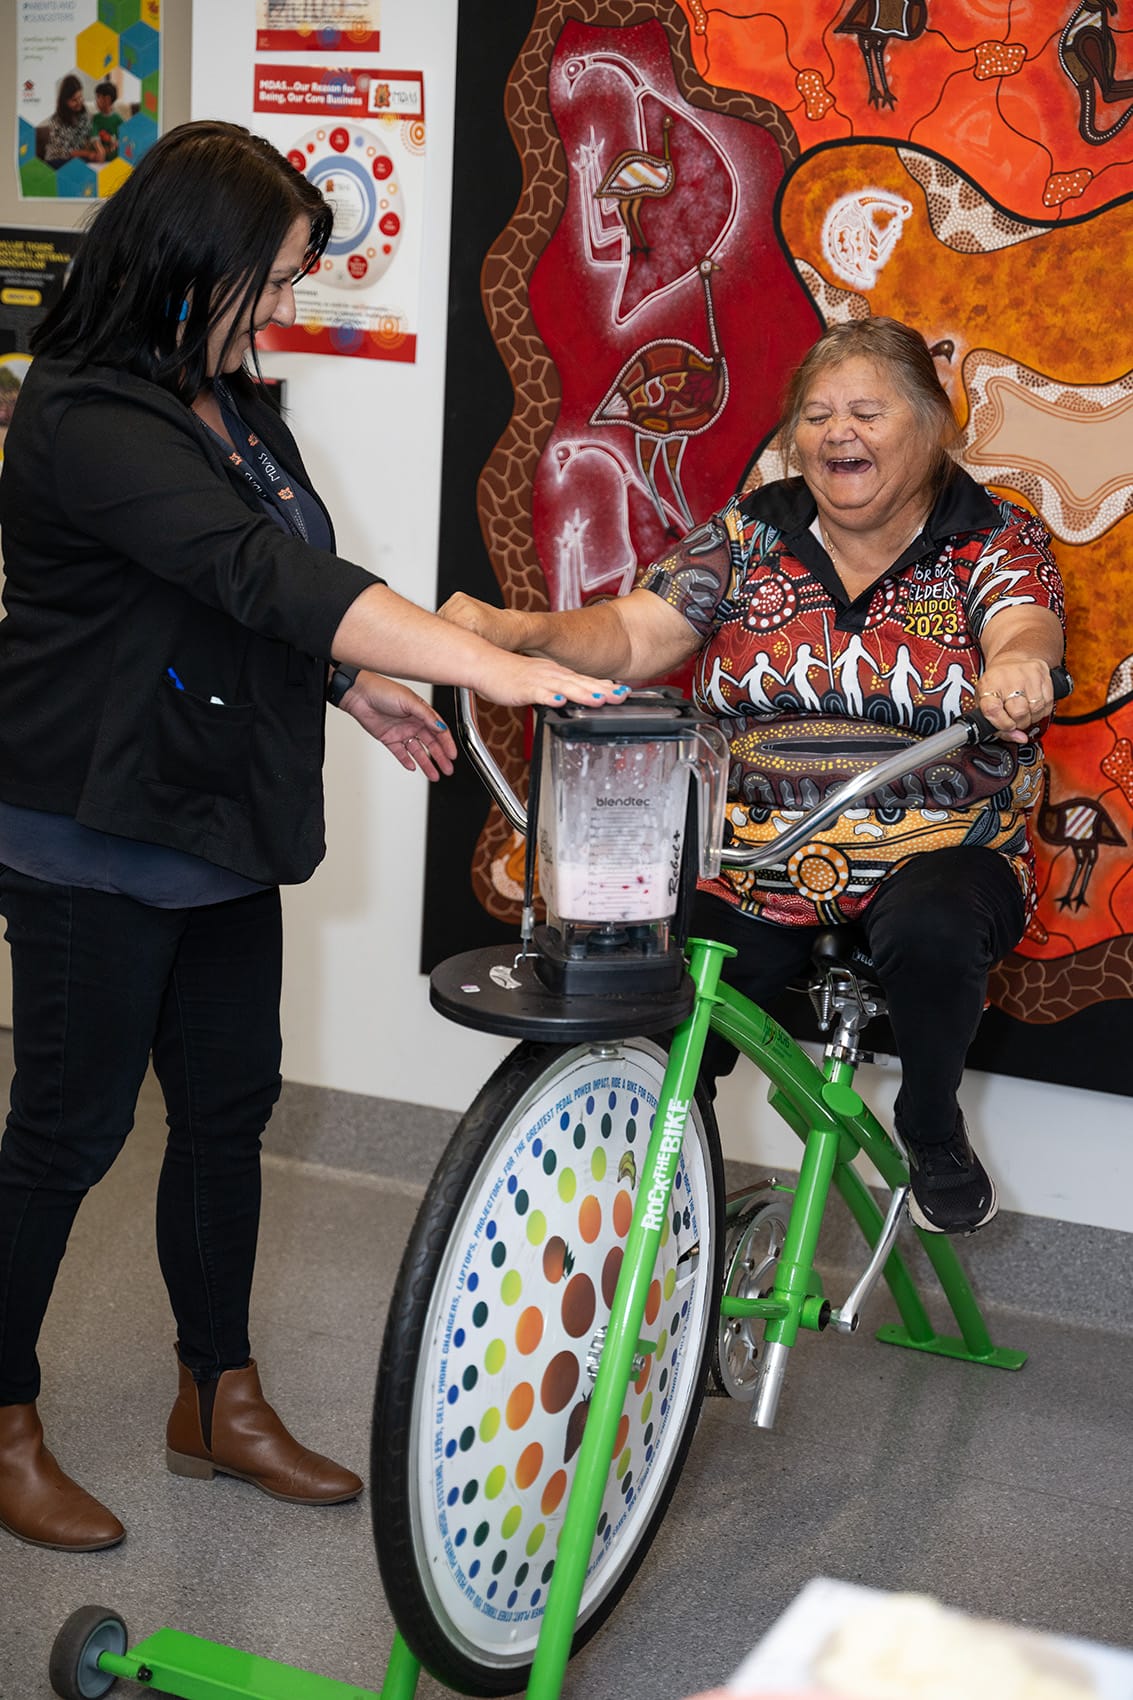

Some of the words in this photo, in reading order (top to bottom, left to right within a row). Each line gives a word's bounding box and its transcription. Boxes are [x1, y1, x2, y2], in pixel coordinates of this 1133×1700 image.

[259, 91, 286, 104] Being,
[287, 93, 304, 102] Our
[305, 94, 325, 104] Core
[326, 95, 362, 106] Business
[311, 82, 341, 92] Reason
[342, 84, 356, 94] for
[258, 452, 281, 482] MDAS
[909, 576, 957, 600] ELDERS
[906, 598, 956, 615] NAIDOC
[904, 614, 958, 636] 2023
[596, 797, 650, 807] blendtec
[573, 1081, 591, 1100] POWER
[611, 1076, 621, 1088] RIDE
[621, 1079, 626, 1089] A
[626, 1080, 638, 1094] BIKE
[634, 1085, 650, 1099] FOR
[555, 1094, 573, 1113] PEDAL
[525, 1107, 554, 1143] GREATEST
[660, 1098, 690, 1154] BIKE
[513, 1140, 526, 1157] THE
[503, 1155, 515, 1175] FOR
[652, 1152, 671, 1180] THE
[641, 1177, 672, 1232] ROCK
[455, 1242, 477, 1290] LAPTOPS,
[442, 1295, 461, 1354] CHARGERS,
[437, 1359, 448, 1393] PHONE
[435, 1399, 444, 1424] CELL
[454, 1565, 467, 1589] PEDAL
